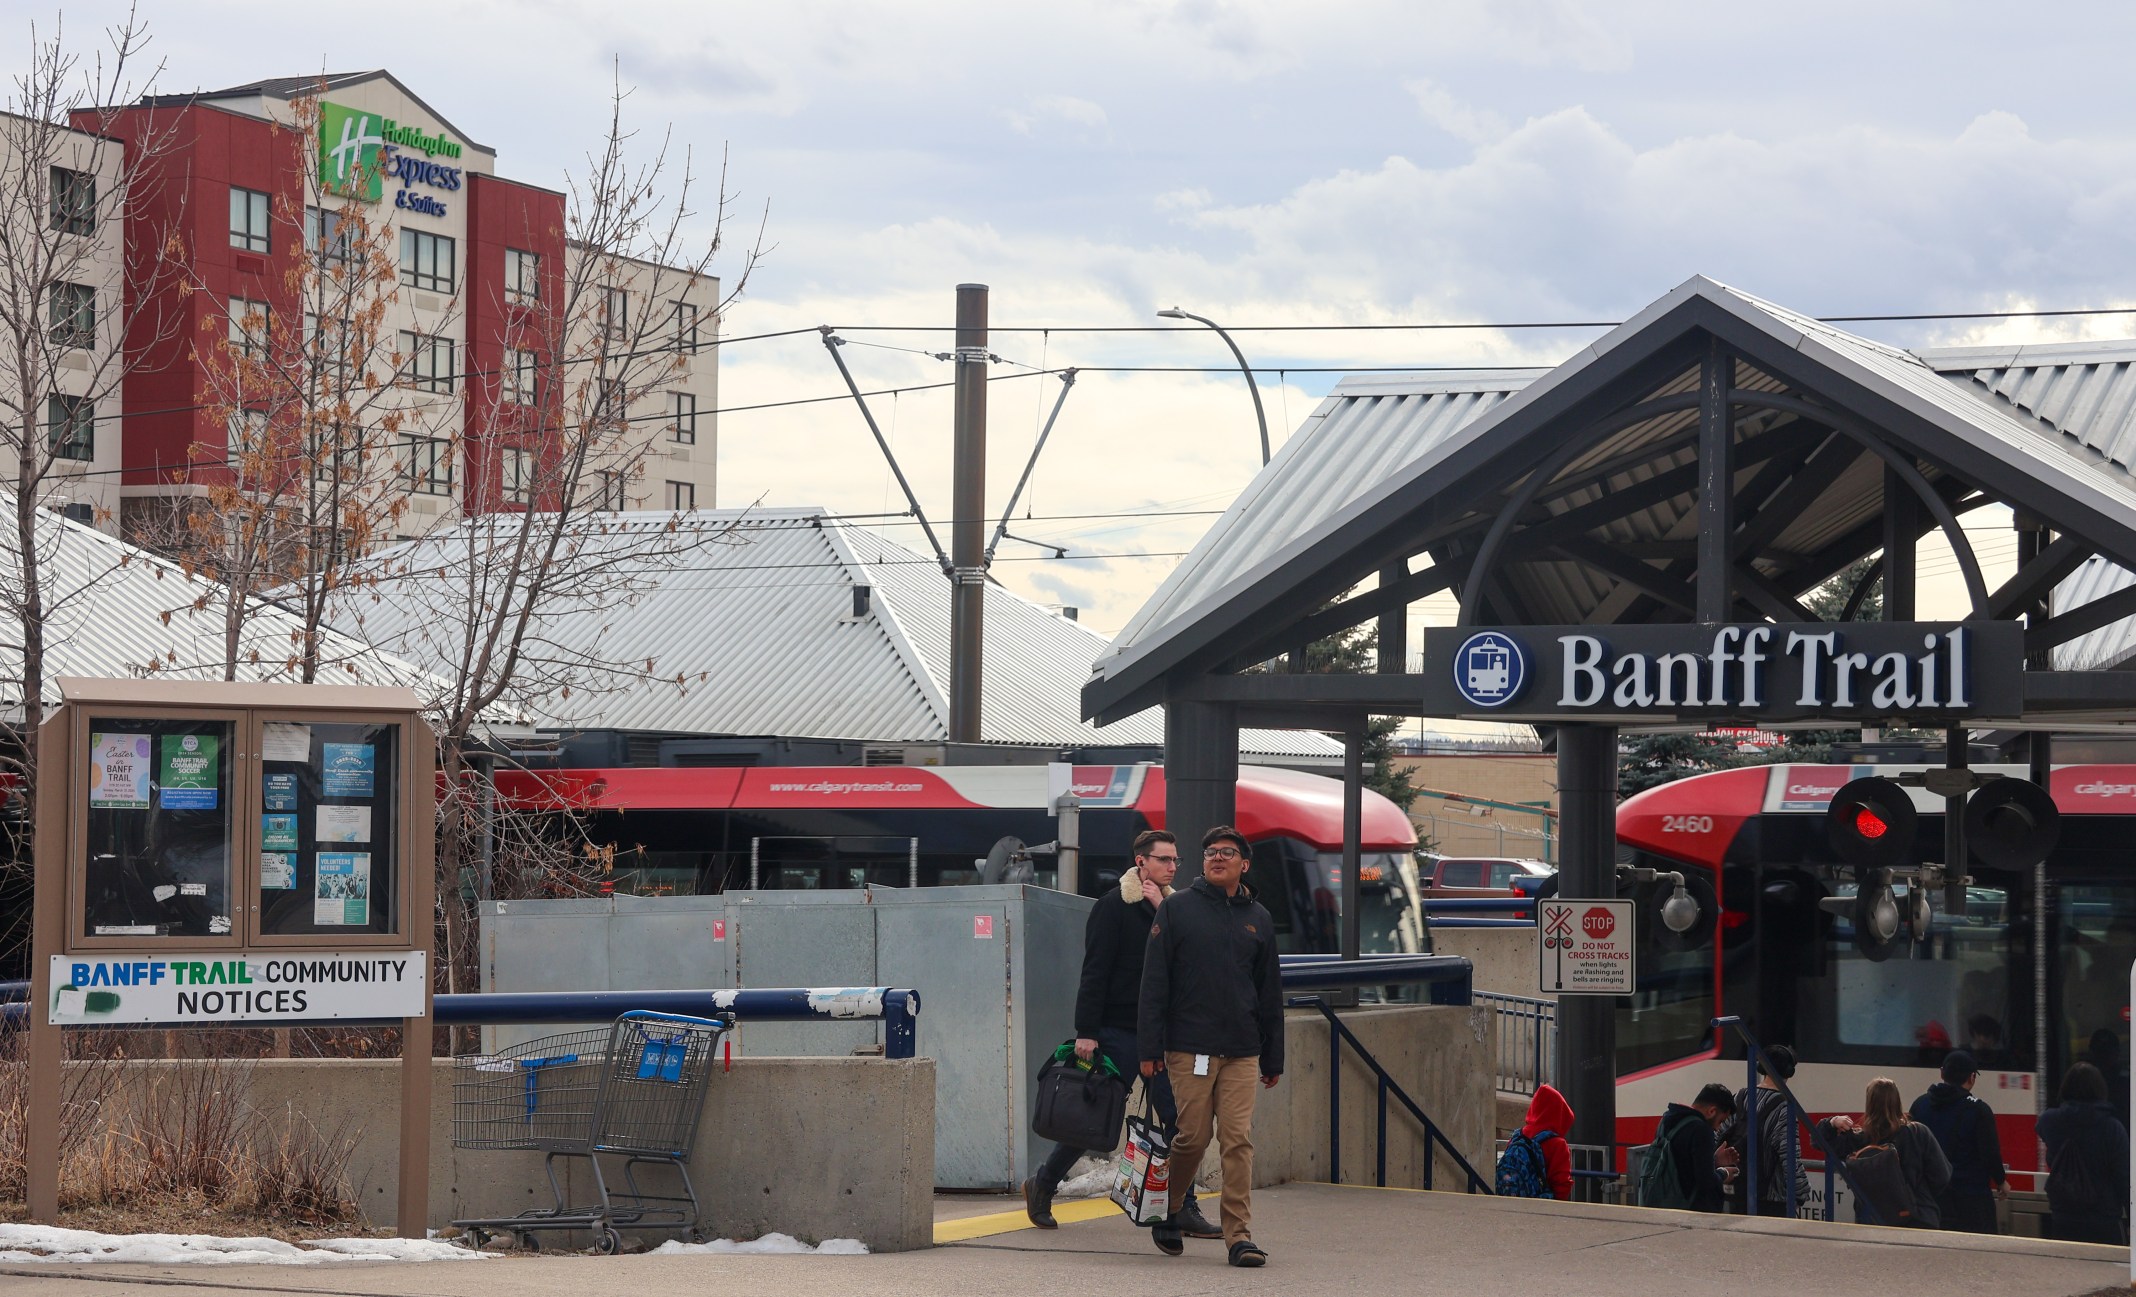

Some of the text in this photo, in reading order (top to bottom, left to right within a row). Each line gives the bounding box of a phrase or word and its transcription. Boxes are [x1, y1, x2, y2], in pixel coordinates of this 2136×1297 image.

[384, 145, 462, 191] Express
[395, 190, 447, 217] & Suites
[1557, 626, 1968, 709] Banff Trail
[106, 746, 134, 758] Easter
[106, 765, 133, 773] BANFF
[108, 774, 131, 782] TRAIL
[770, 781, 923, 794] www.calgarytransit.com
[1662, 815, 1713, 833] 2460
[1584, 917, 1613, 929] STOP
[1582, 942, 1615, 950] DO NOT
[1597, 952, 1629, 960] TRACKS
[71, 960, 407, 987] BANFF TRAIL COMMUNITY
[177, 989, 307, 1014] NOTICES
[1812, 1190, 1844, 1204] NT
